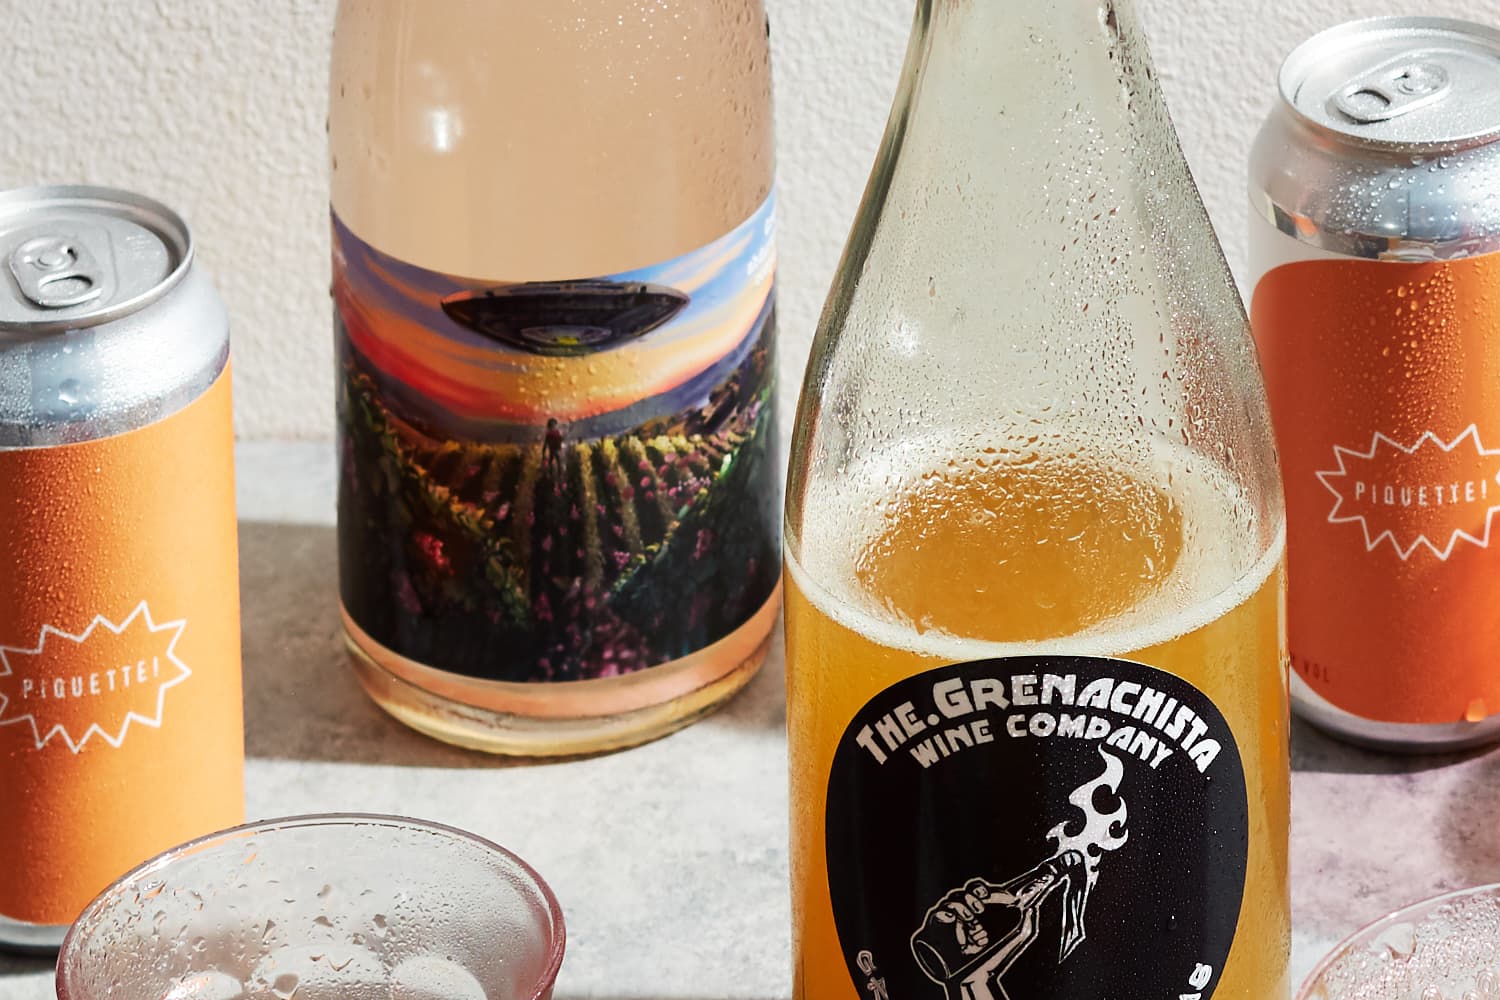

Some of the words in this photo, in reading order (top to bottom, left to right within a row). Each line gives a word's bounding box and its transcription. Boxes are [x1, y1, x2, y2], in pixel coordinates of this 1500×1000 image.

[1355, 480, 1487, 506] PIQUETTE!
[23, 656, 159, 699] PIQUETTE!
[910, 718, 994, 769] WINE
[1006, 712, 1174, 770] COMPANY
[932, 674, 1221, 774] GRENACHISTA
